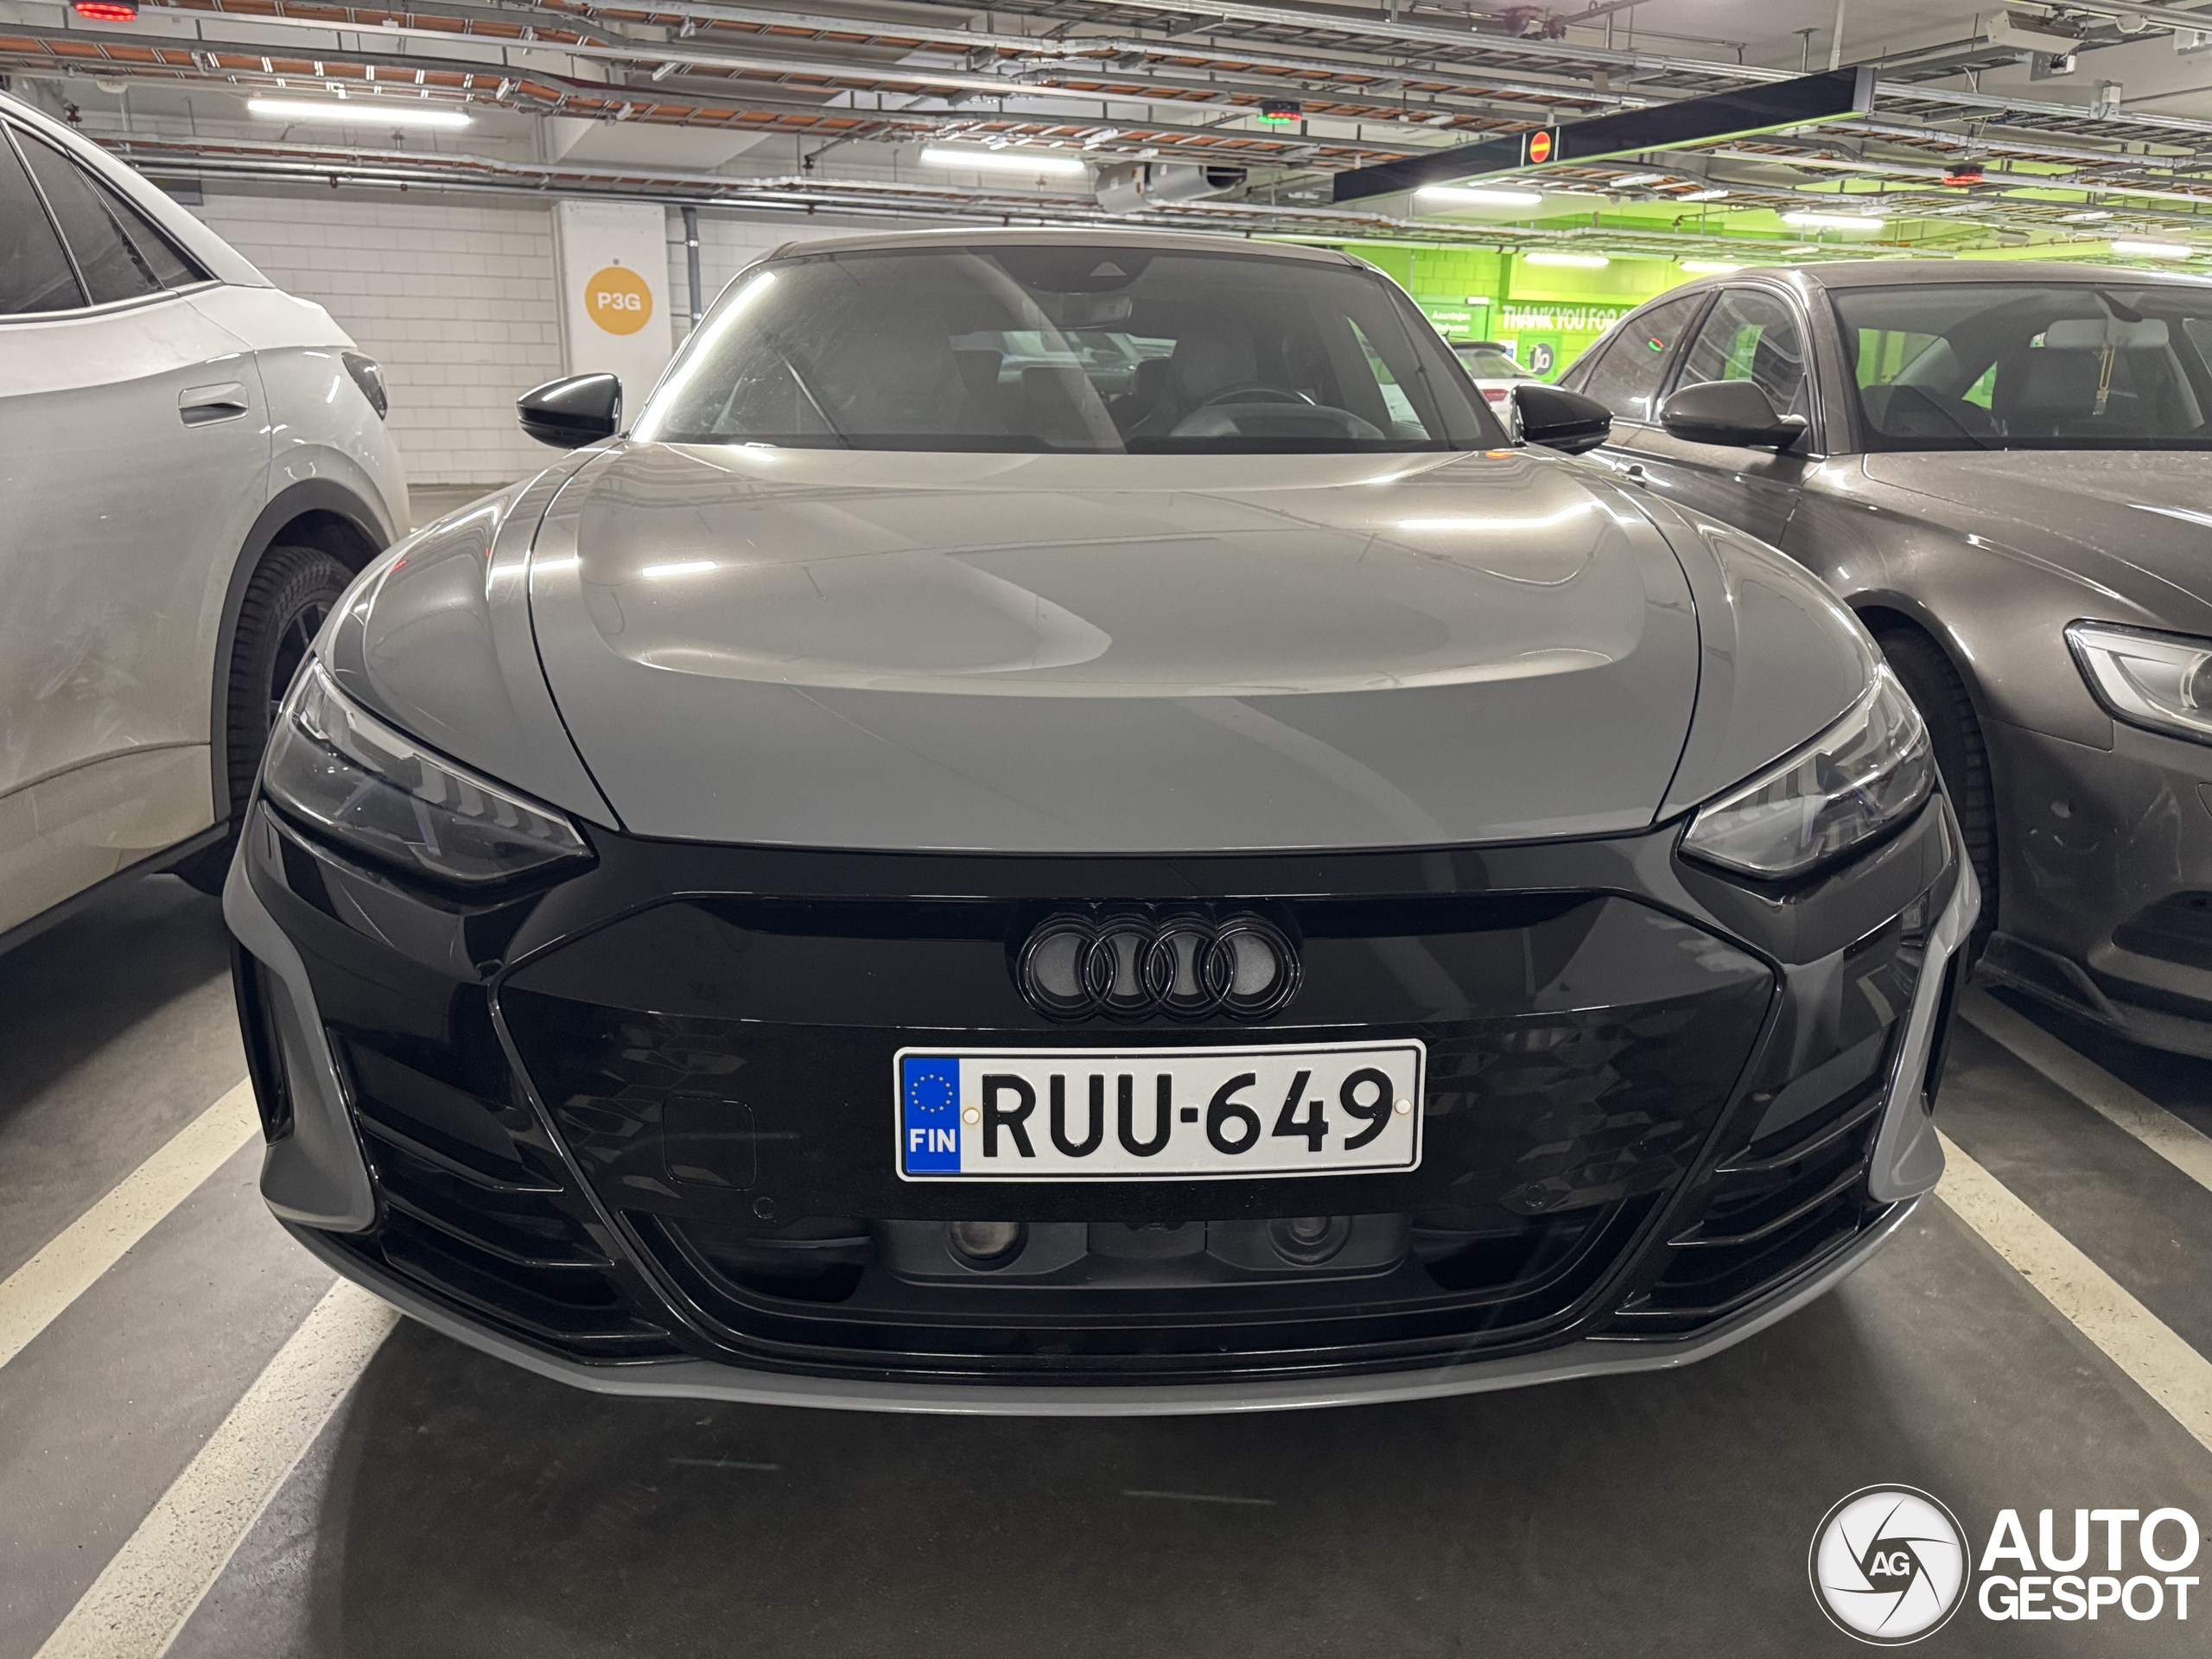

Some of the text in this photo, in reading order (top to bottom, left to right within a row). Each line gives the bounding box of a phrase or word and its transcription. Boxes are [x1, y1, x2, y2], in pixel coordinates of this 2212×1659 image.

[597, 291, 642, 311] P3G
[1502, 304, 1618, 332] THANK YOU FOR
[982, 1066, 1394, 1158] RUU-649
[910, 1128, 956, 1153] FIN
